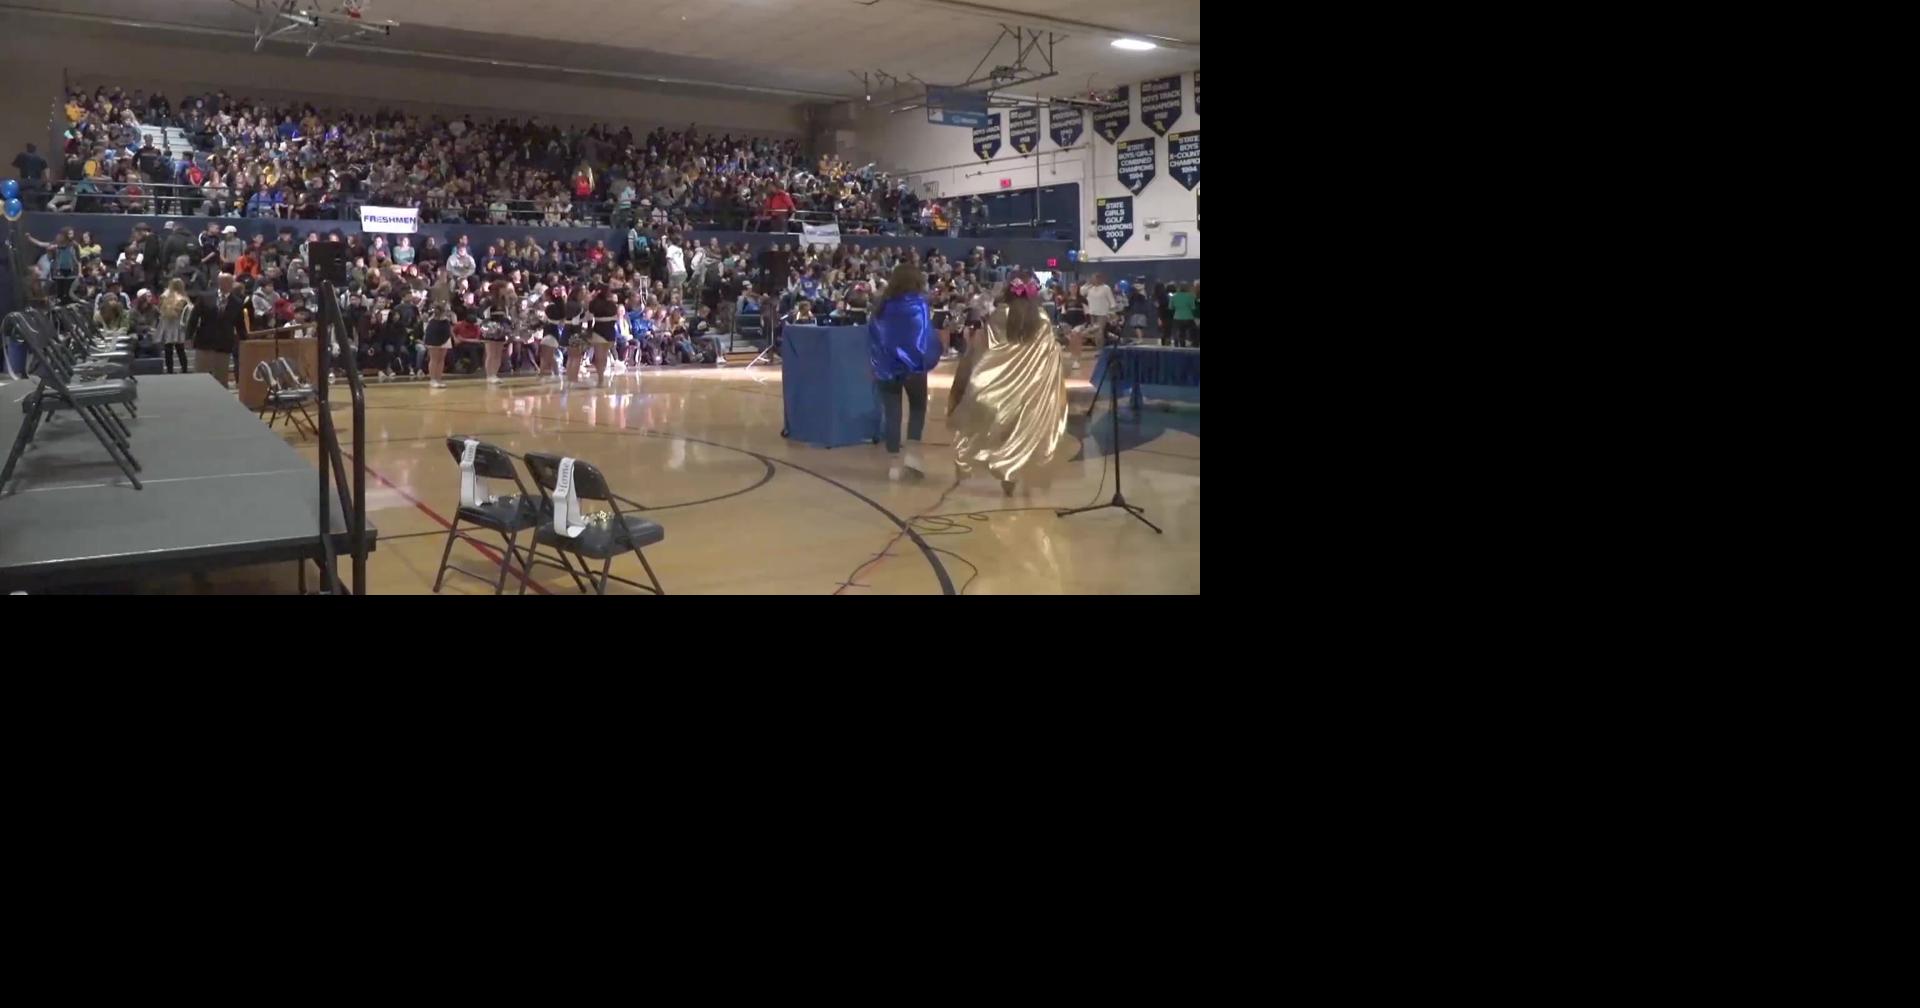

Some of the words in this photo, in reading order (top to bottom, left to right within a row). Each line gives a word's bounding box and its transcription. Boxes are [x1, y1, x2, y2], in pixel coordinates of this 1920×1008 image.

[1142, 94, 1159, 103] BOYS
[1159, 89, 1181, 99] TRACK
[1142, 99, 1180, 112] CHAMPIONS
[1094, 109, 1129, 121] CHAMPIONS
[1023, 118, 1040, 126] TRAC
[1051, 117, 1082, 129] CHAMPIONS
[1010, 127, 1040, 137] CHAMPION
[973, 134, 1000, 144] CHAMPIONS
[1178, 135, 1200, 144] STATE
[1127, 143, 1144, 151] STATE
[1179, 143, 1199, 151] BOYS
[1118, 150, 1154, 160] BOYS/GIRLS
[1169, 150, 1200, 159] X-COUNT
[1120, 157, 1152, 166] COMBINED
[1169, 158, 1200, 167] CHAMPIO
[1119, 164, 1154, 173] CHAMPIONS
[1105, 201, 1124, 209] STATE
[1104, 209, 1125, 217] GIRLS
[363, 215, 416, 224] FRESHMEN
[1105, 216, 1124, 224] GOLF
[1097, 222, 1133, 232] CHAMPIONS
[1106, 230, 1124, 238] 2003
